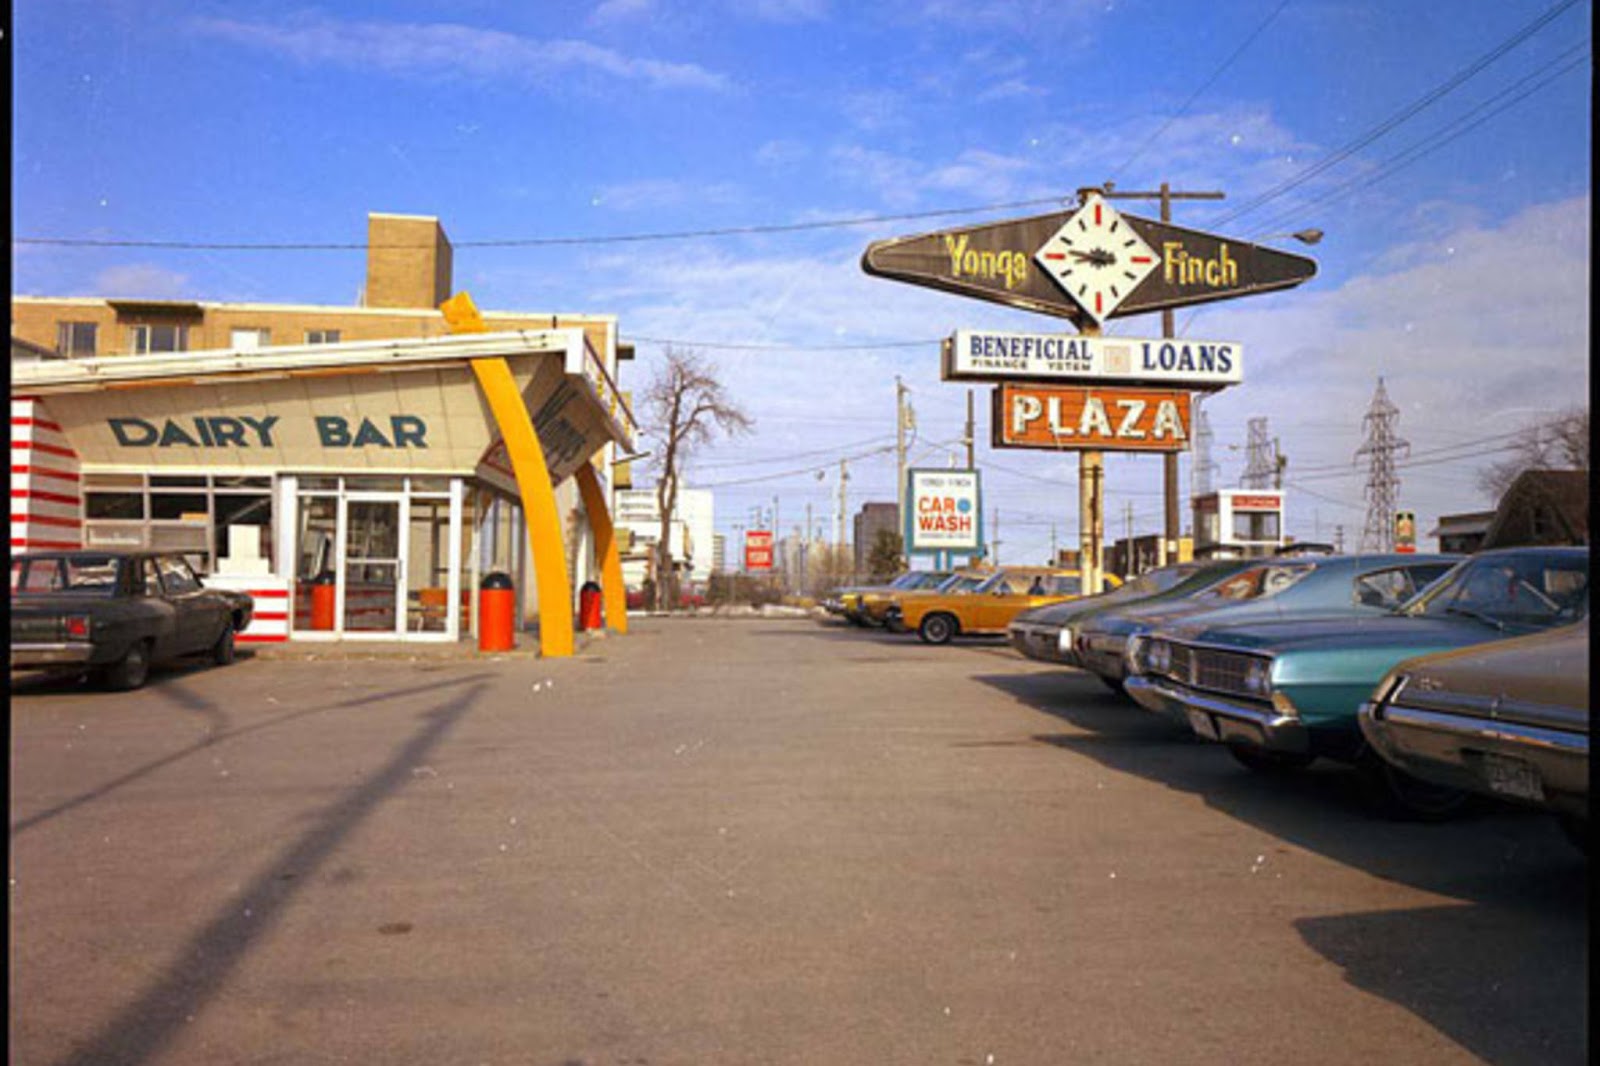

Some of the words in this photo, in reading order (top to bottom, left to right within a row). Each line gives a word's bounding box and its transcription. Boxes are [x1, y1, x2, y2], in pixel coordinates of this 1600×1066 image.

[1163, 242, 1238, 287] Finch
[970, 334, 1093, 361] BENEFICIAL
[1142, 343, 1233, 374] LOANS
[107, 415, 279, 448] DAIRY
[314, 415, 428, 449] BAR
[1012, 394, 1187, 440] PLAZA
[918, 496, 956, 514] CAR
[918, 516, 972, 532] WASH
